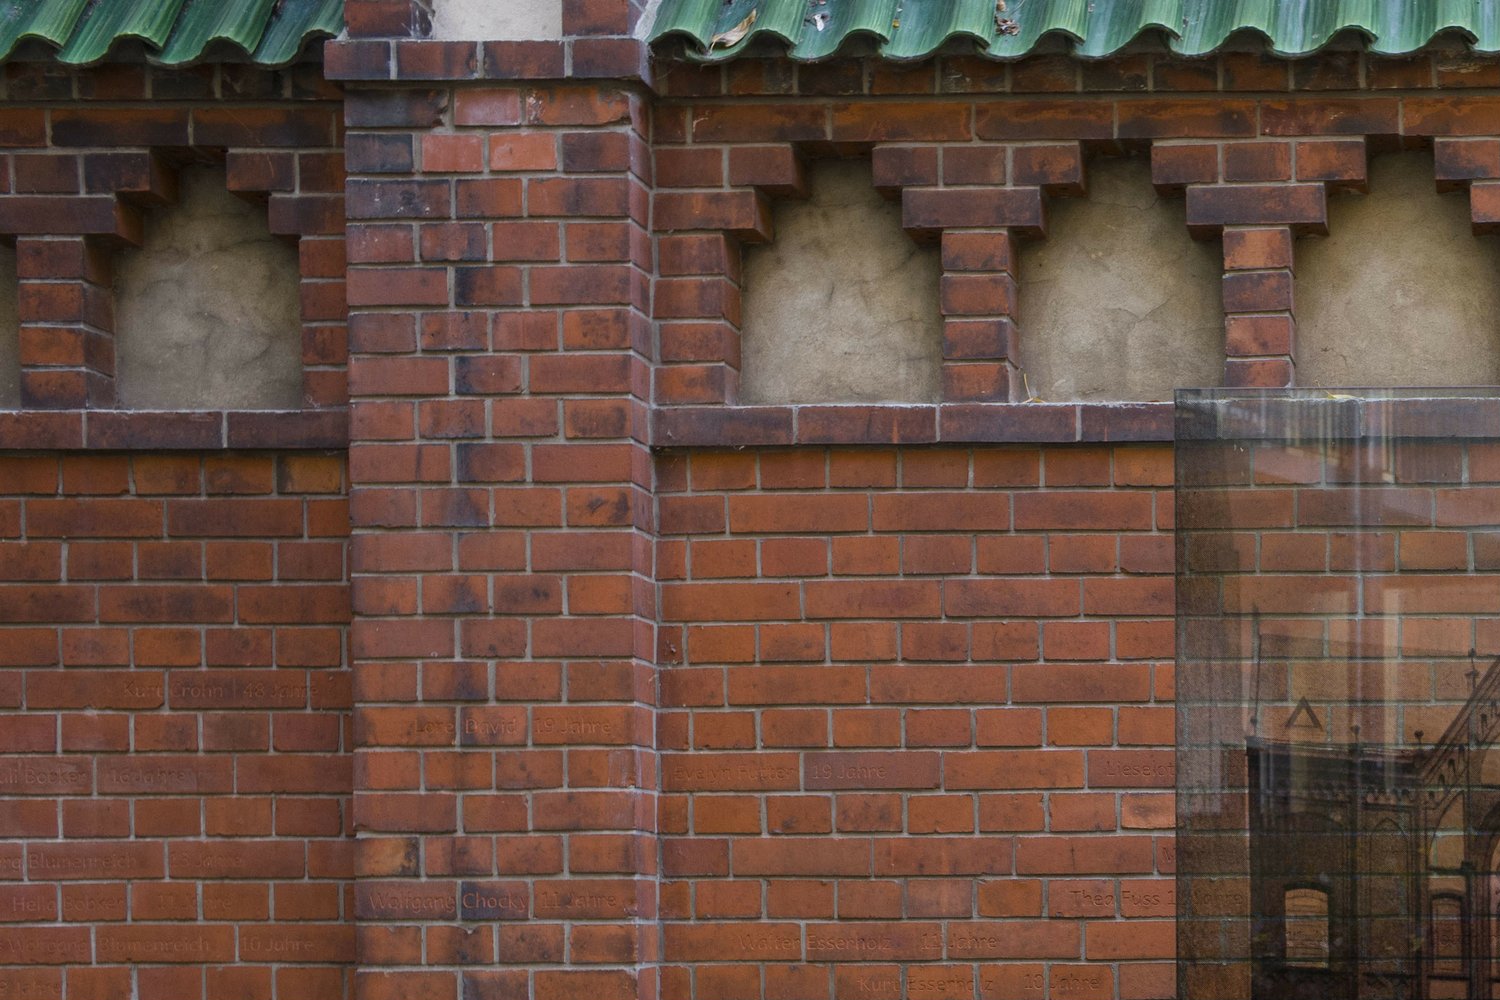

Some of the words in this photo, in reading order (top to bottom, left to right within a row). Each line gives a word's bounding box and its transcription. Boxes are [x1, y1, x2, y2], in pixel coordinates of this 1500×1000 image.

[464, 718, 518, 734] David
[561, 718, 611, 734] Jahre
[463, 892, 530, 913] Chocky
[566, 892, 617, 908] Jahre
